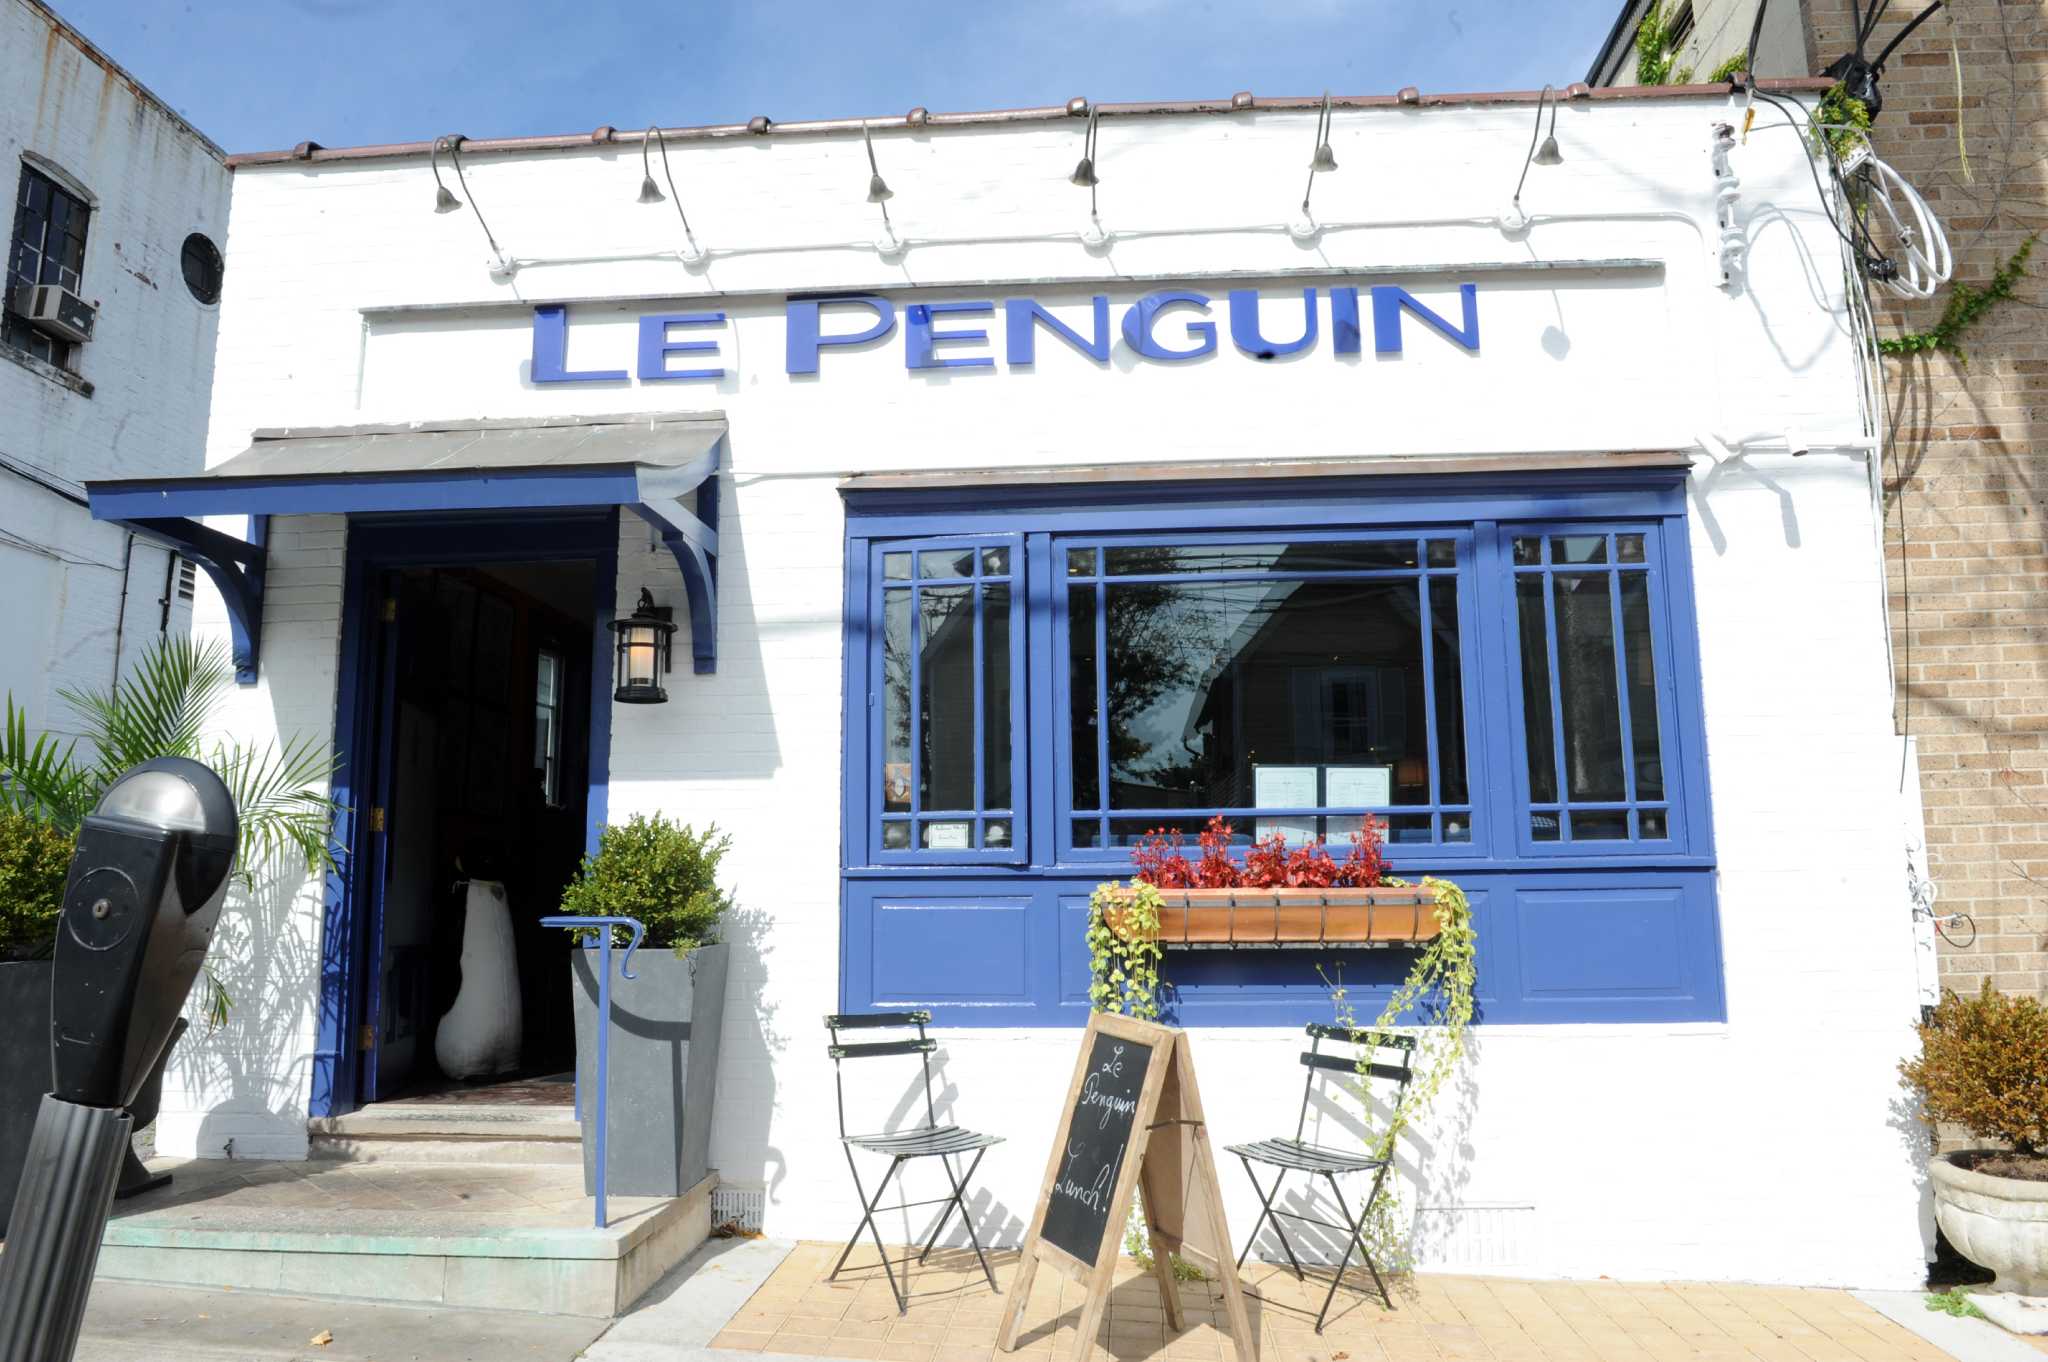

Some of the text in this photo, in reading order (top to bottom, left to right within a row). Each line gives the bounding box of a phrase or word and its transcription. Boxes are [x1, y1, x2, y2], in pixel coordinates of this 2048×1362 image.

[531, 284, 1480, 382] LE PENGUIN
[1102, 1045, 1123, 1078] Le
[1081, 1072, 1136, 1130] Penguin
